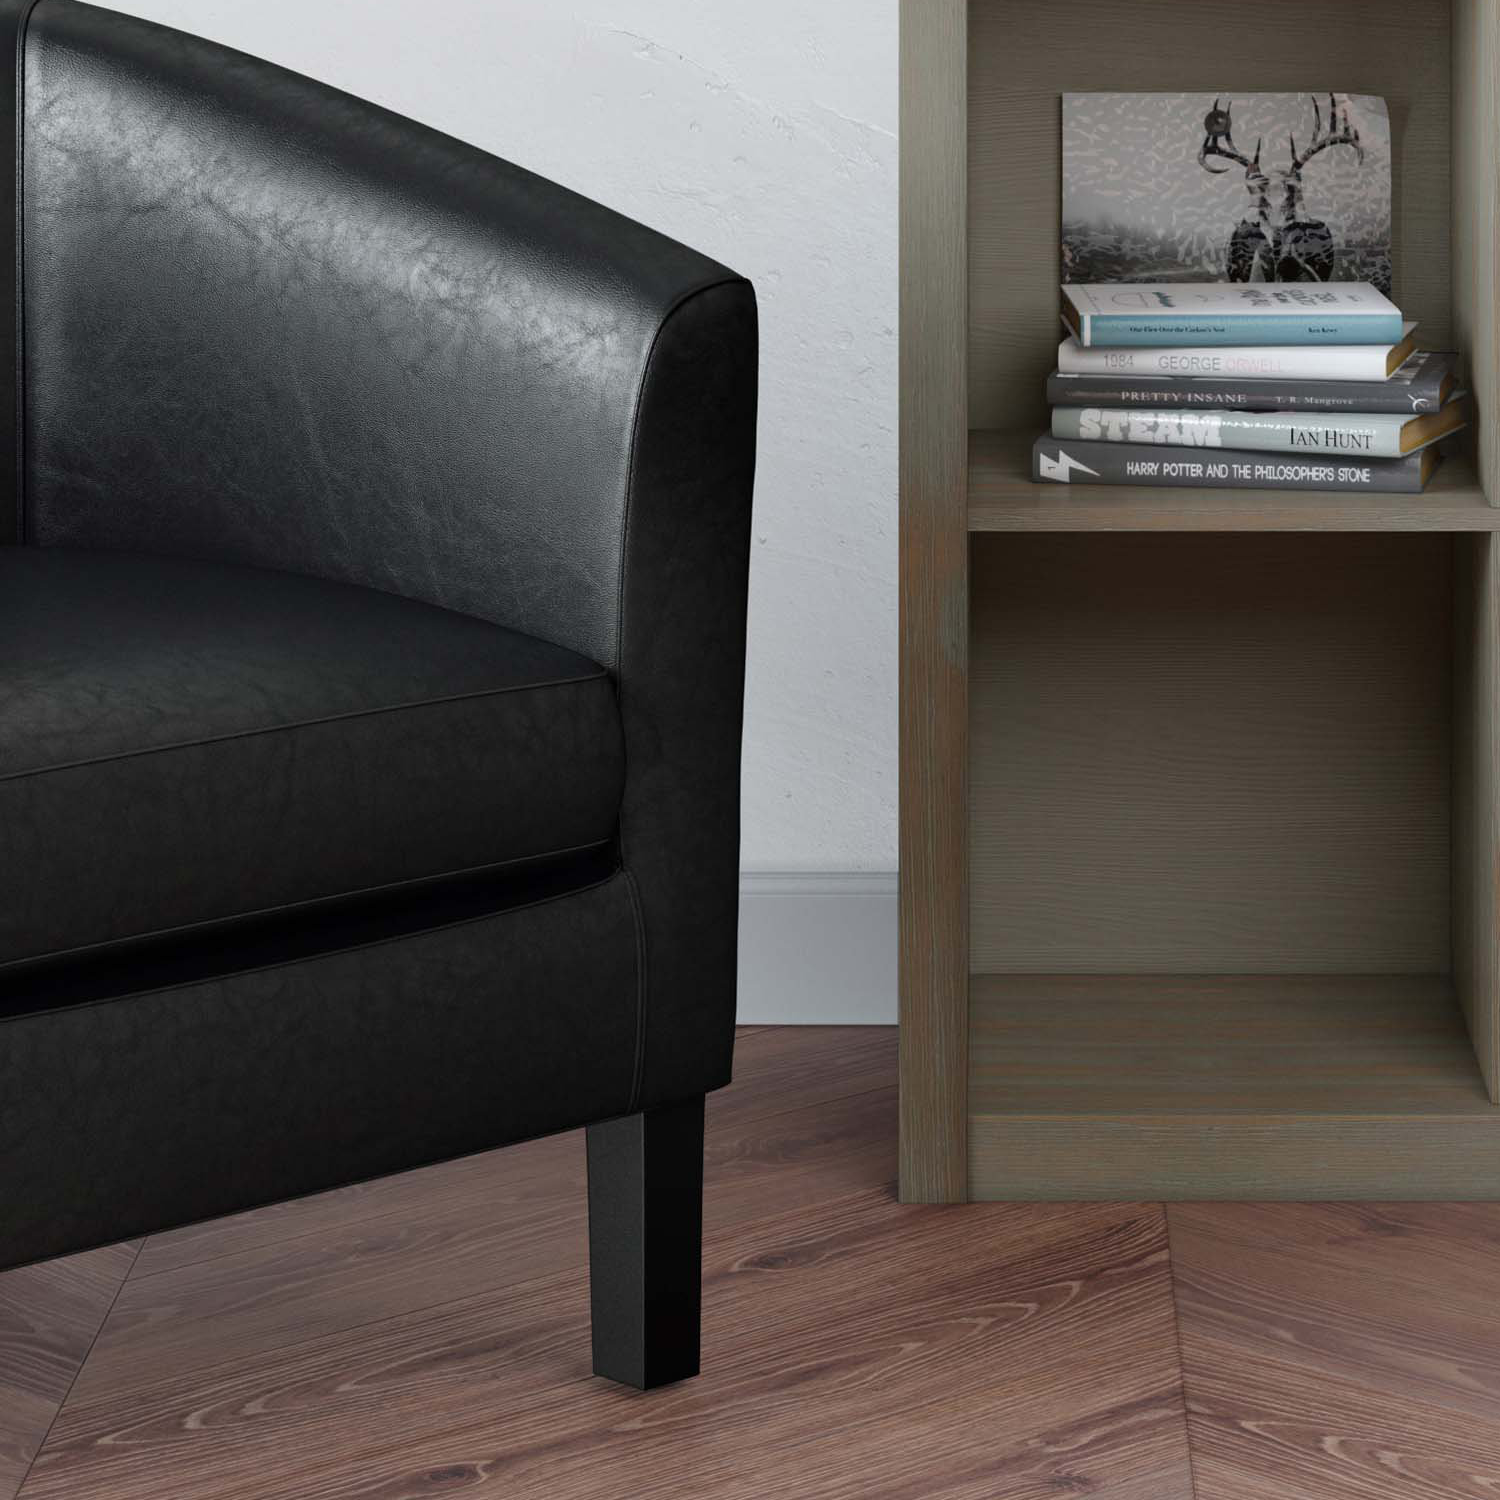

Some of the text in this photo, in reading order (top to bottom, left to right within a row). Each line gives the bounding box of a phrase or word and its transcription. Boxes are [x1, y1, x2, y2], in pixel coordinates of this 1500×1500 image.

[1103, 354, 1135, 368] 1984
[1158, 355, 1221, 371] GEORGE
[1121, 391, 1182, 402] PRETTY
[1187, 392, 1247, 403] INSANE
[1304, 396, 1354, 407] Mangrove
[1079, 407, 1222, 447] STEAM
[1126, 461, 1371, 482] HARRY POTTER AND THE PHILOSOPHER'S STONE
